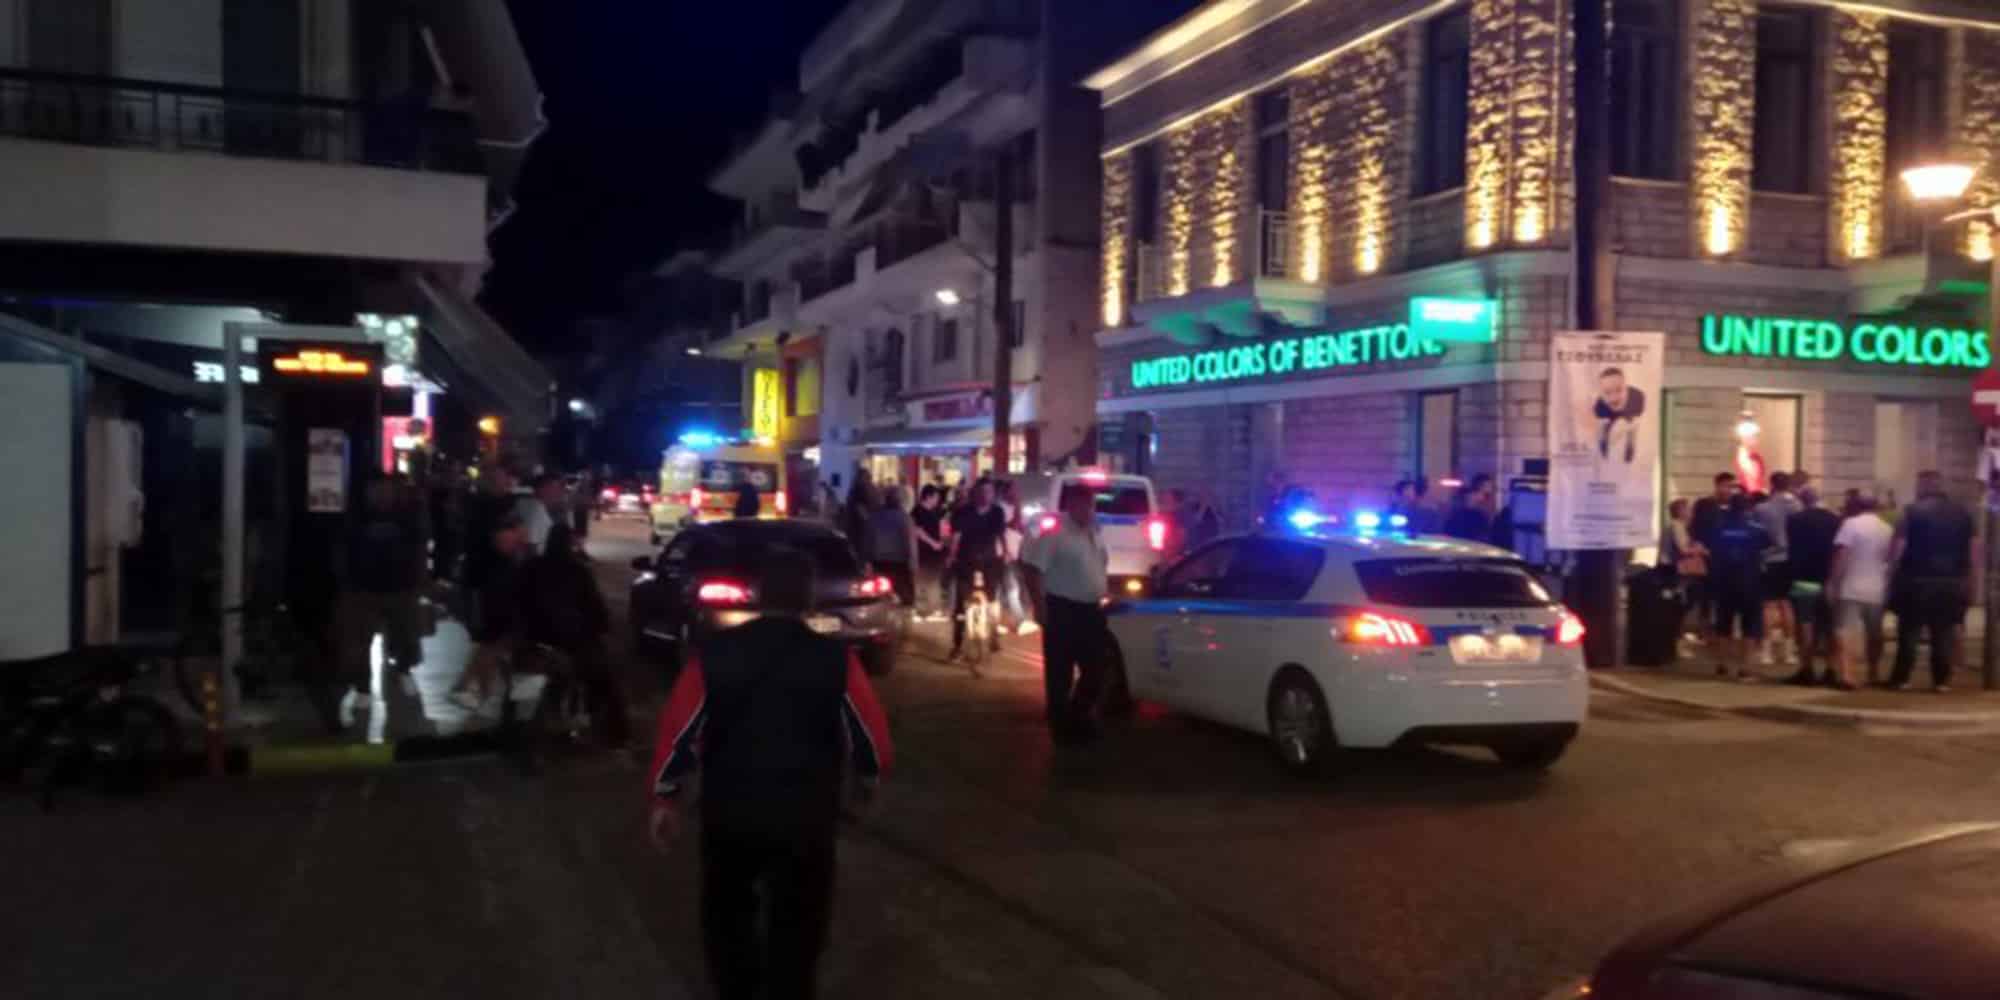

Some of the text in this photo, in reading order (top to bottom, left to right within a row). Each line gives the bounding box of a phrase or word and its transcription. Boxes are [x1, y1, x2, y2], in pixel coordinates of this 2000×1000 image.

[1132, 356, 1190, 387] UNITED
[1193, 343, 1265, 383] COLORS
[1269, 339, 1300, 373] OF
[1703, 314, 1991, 368] UNITED COLORS
